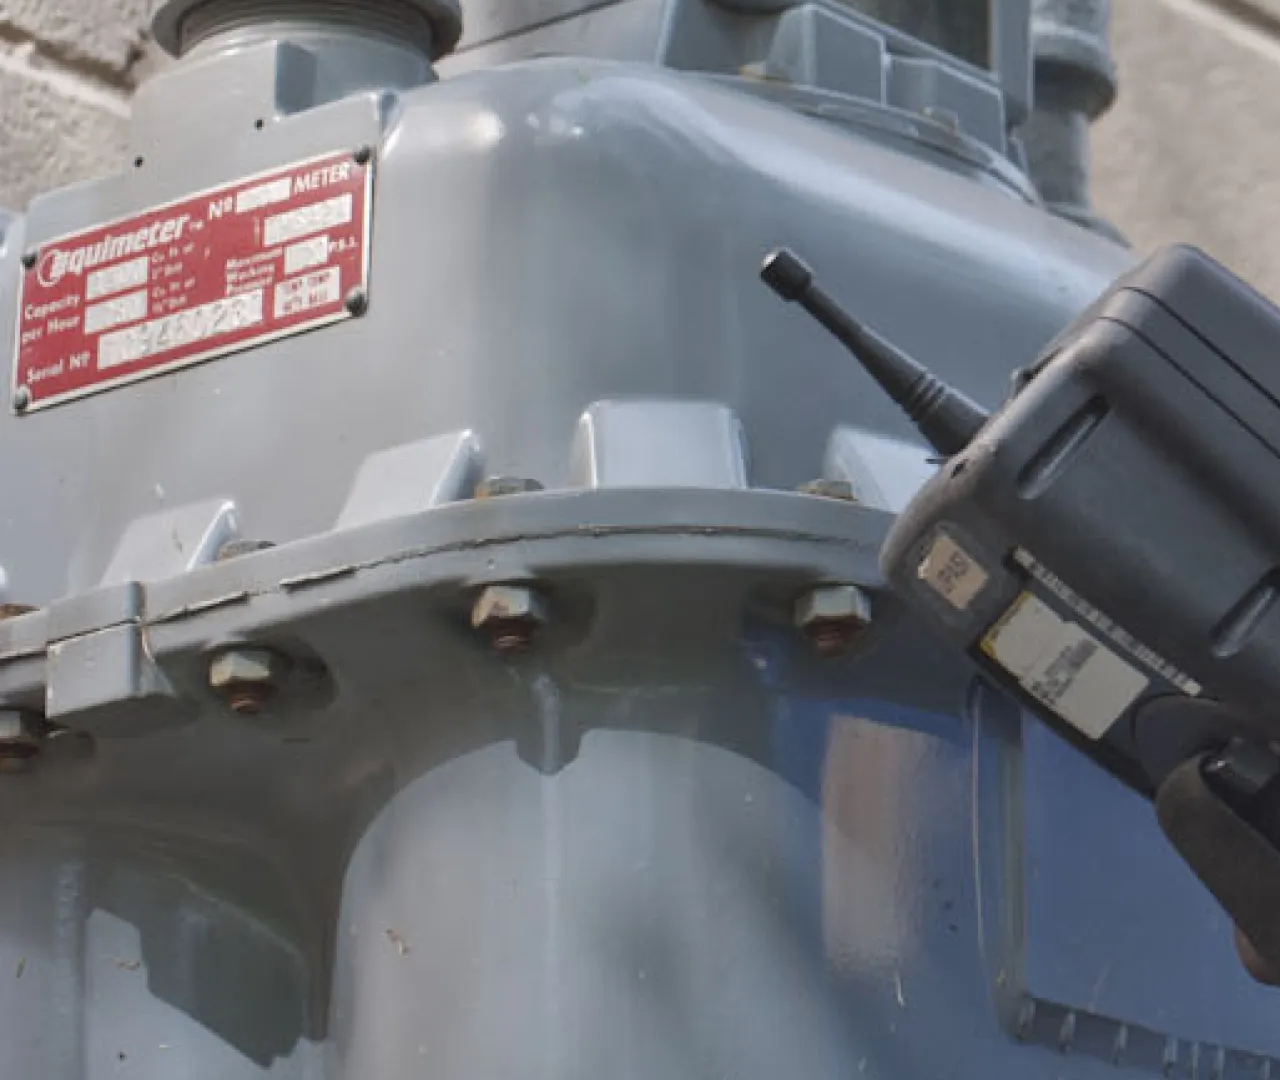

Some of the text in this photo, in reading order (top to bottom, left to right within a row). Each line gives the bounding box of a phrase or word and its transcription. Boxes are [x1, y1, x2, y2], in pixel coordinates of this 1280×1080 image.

[294, 162, 351, 195] METER
[24, 294, 80, 321] Capacity
[46, 316, 80, 335] Hour
[27, 358, 65, 384] Serial
